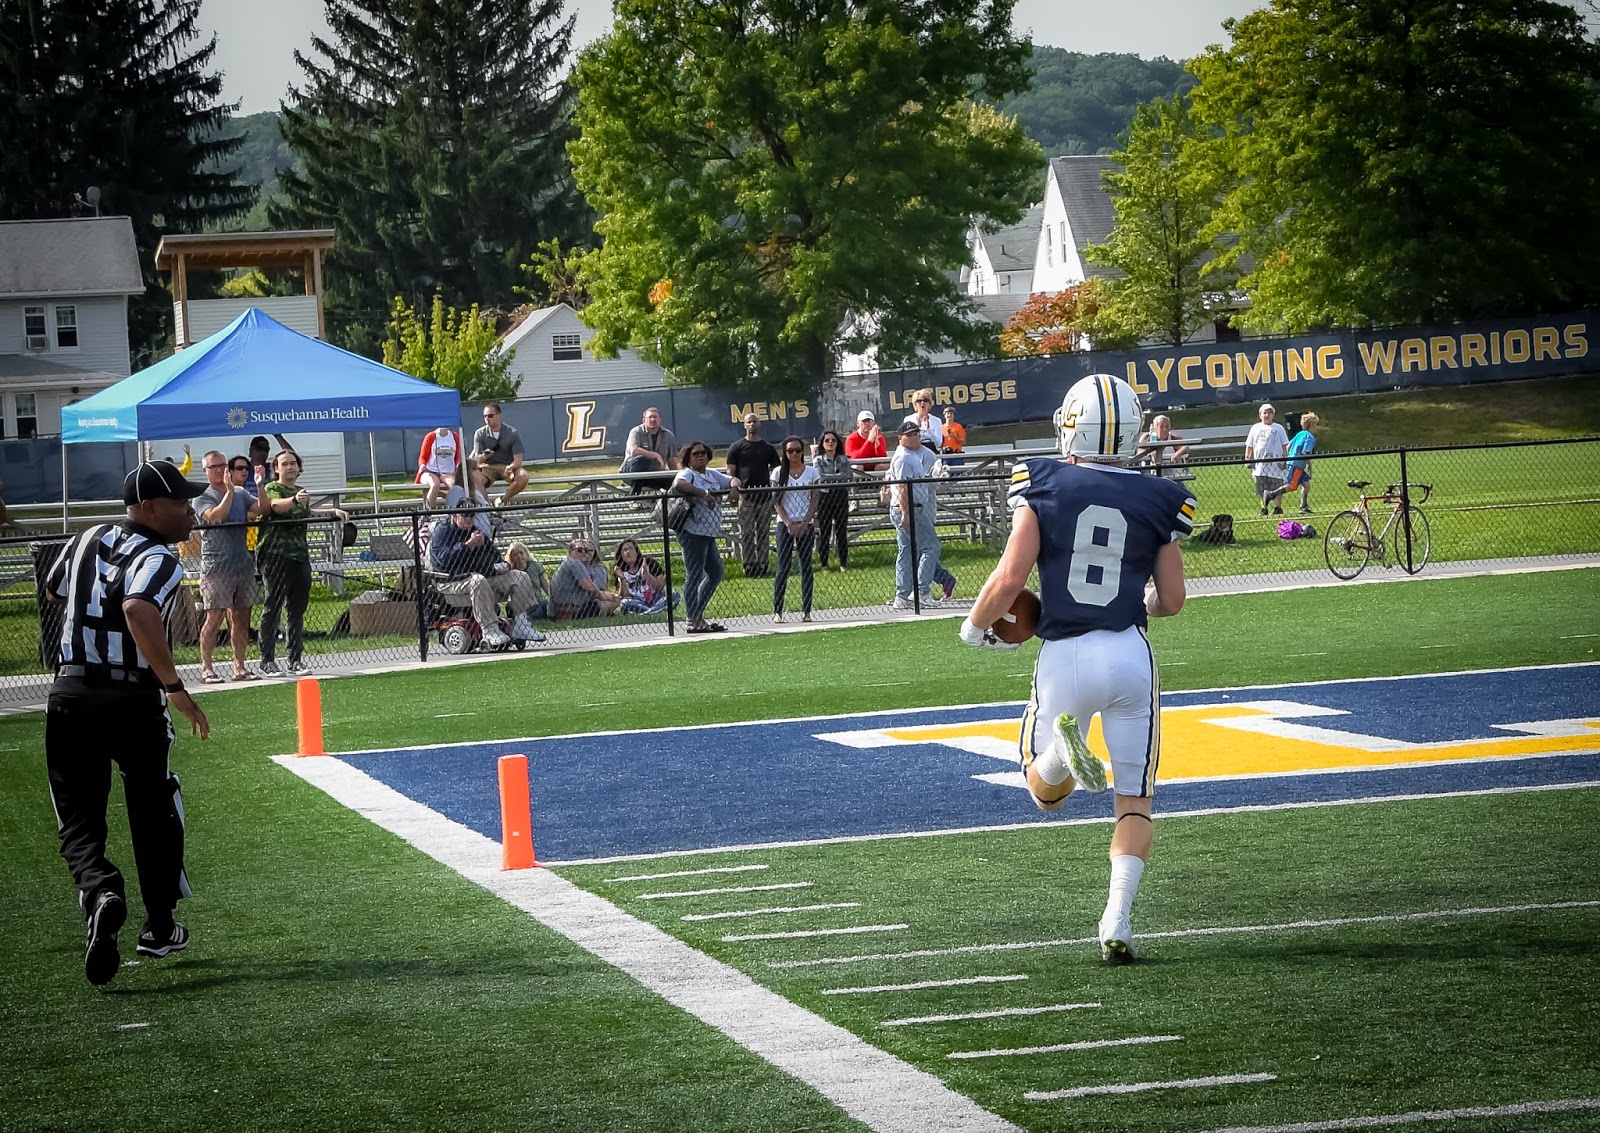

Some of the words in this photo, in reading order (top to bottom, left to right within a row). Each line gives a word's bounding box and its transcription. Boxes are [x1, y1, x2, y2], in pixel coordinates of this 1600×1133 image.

[1126, 344, 1344, 395] LYCOMING
[1357, 323, 1589, 376] WARRIORS
[250, 408, 329, 424] Susquehanna
[330, 406, 370, 419] Health
[562, 400, 607, 453] L
[730, 399, 810, 423] MEN'S
[889, 379, 1018, 411] LAROSSE
[1066, 504, 1128, 607] 8
